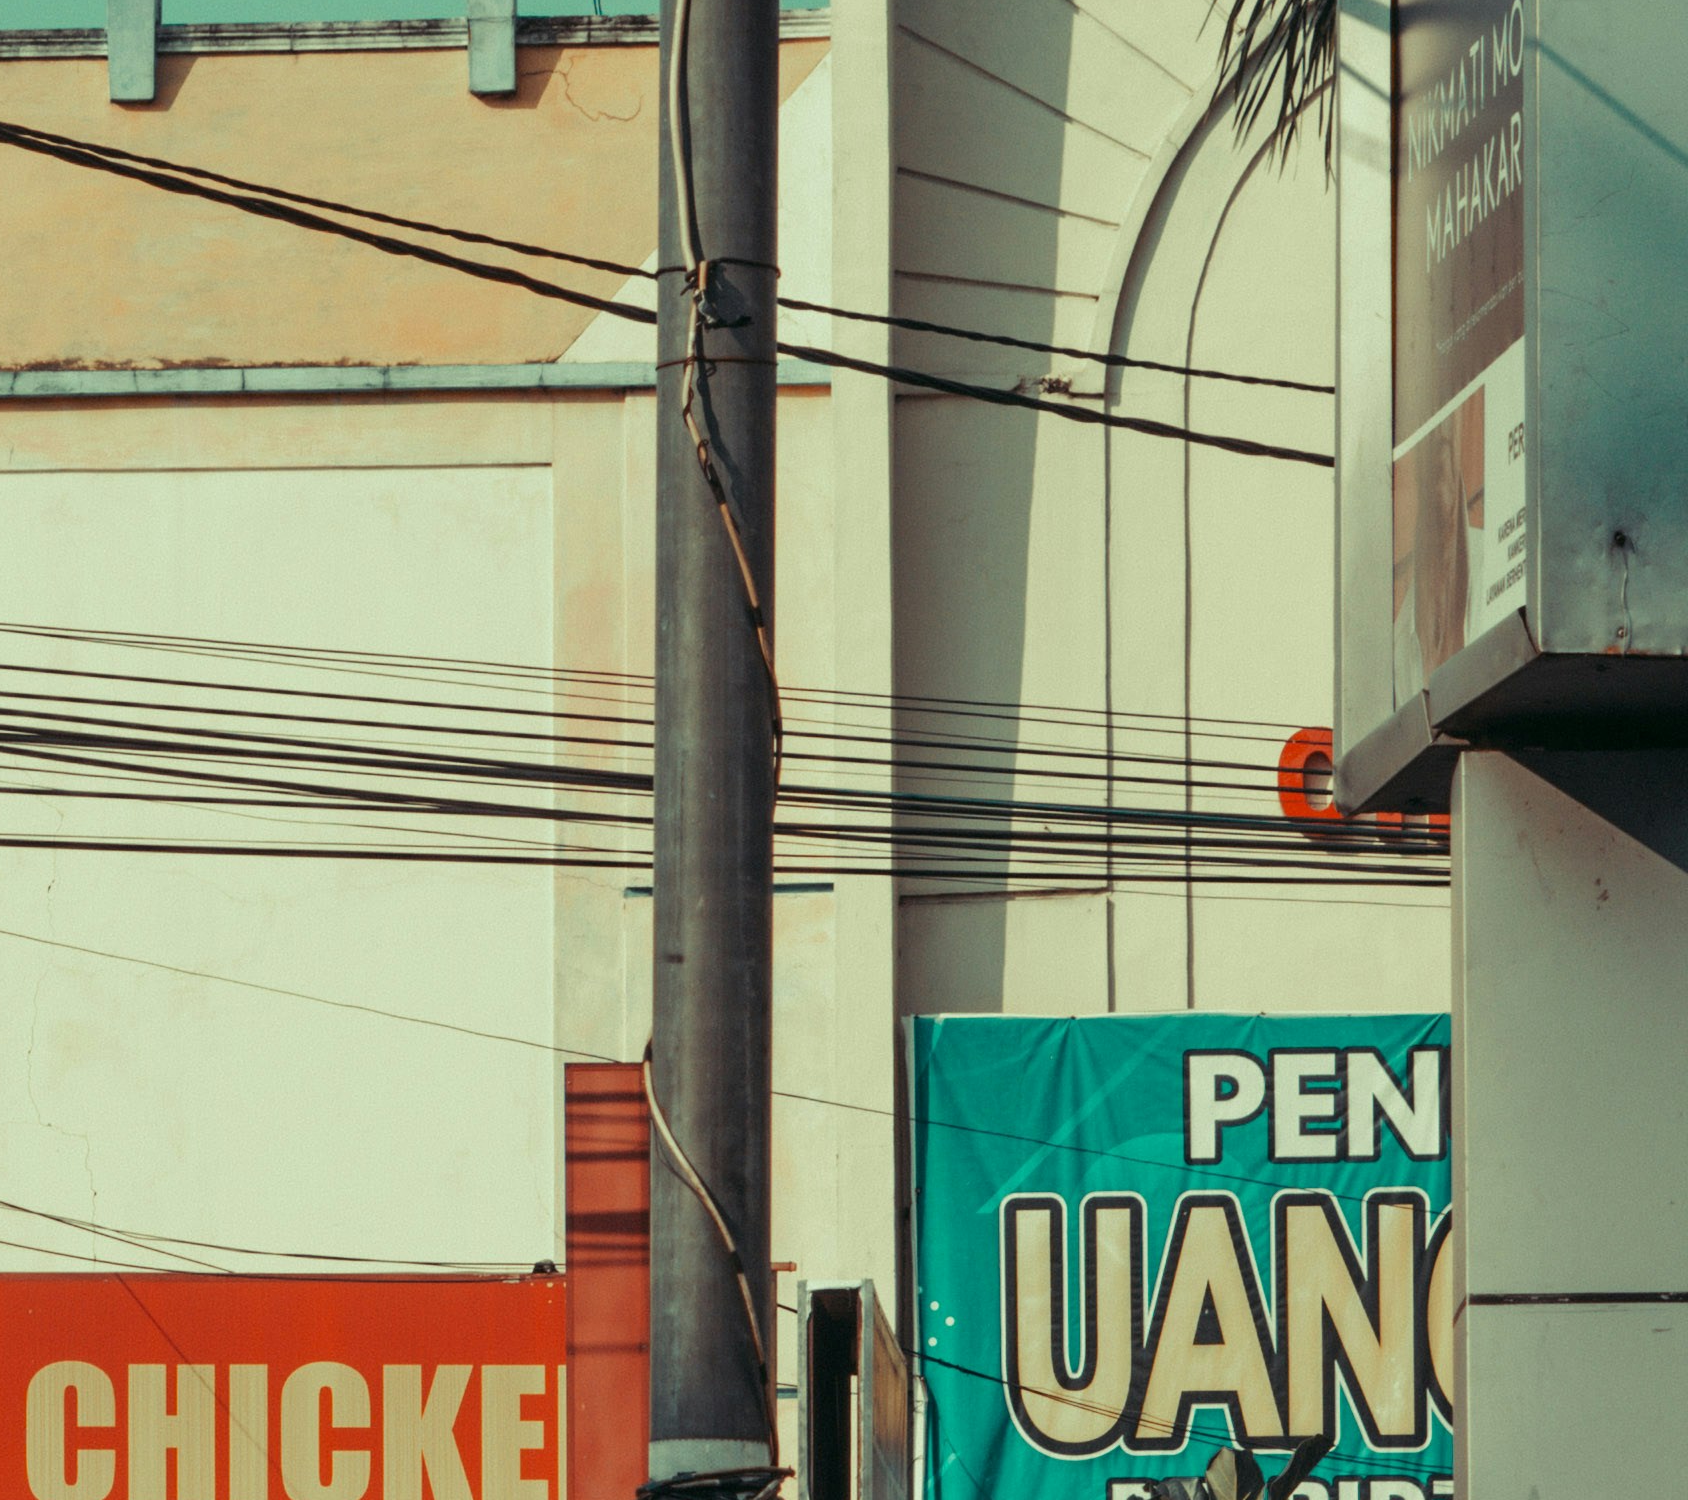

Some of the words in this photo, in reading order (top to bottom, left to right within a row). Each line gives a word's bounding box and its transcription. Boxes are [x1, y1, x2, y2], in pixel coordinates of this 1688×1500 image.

[1408, 35, 1485, 182] NIKMATI
[1426, 111, 1523, 273] MAHAKAR
[1188, 1049, 1442, 1161] PEN
